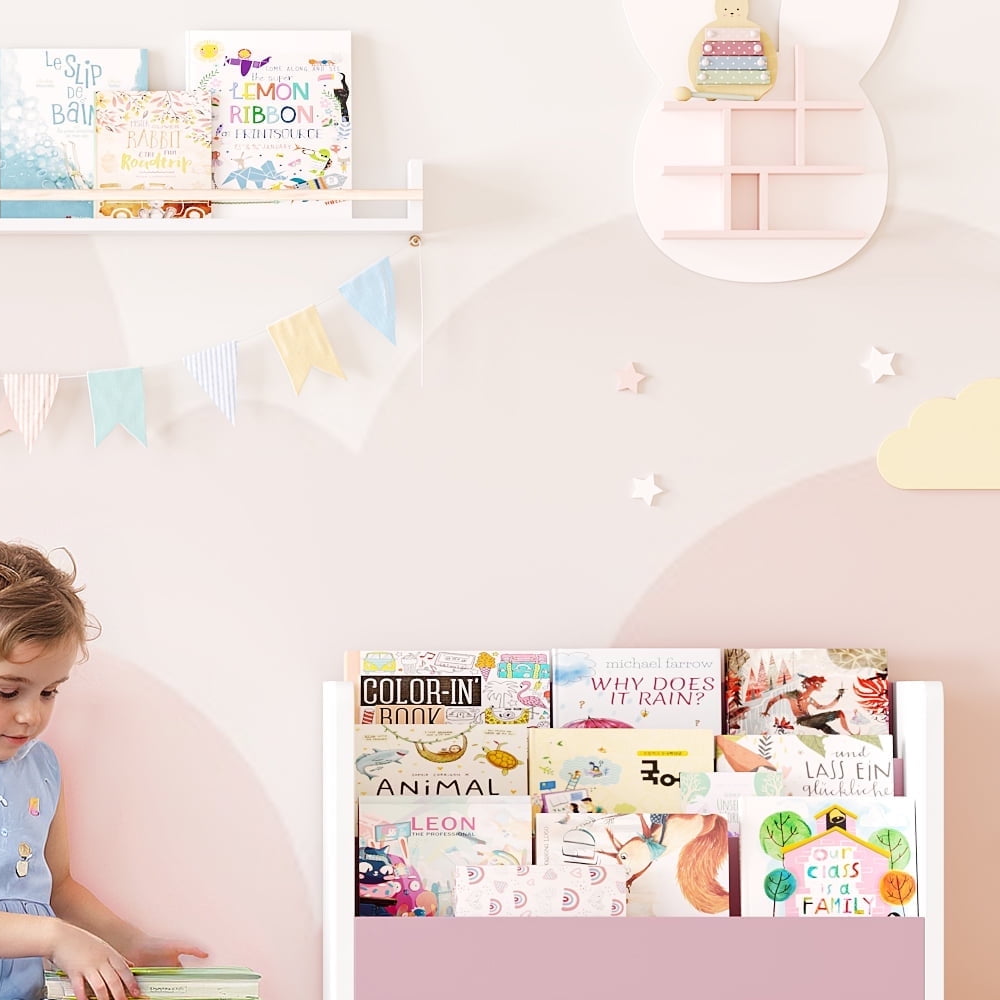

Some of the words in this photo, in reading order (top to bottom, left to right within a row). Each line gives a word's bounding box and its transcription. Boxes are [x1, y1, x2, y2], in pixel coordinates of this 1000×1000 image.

[45, 51, 61, 70] Le
[229, 82, 309, 100] LEMON
[230, 105, 314, 124] RIBBON
[127, 129, 181, 149] RABBIT
[606, 657, 661, 669] michael
[666, 657, 713, 669] farrow
[363, 677, 481, 706] COLOR-IN'
[591, 677, 644, 691] WHY
[653, 676, 715, 691] DOES
[611, 692, 630, 705] IT
[639, 691, 705, 706] RAIN?
[411, 816, 476, 831] LEON
[839, 883, 850, 895] a
[803, 896, 874, 915] FAMILY
